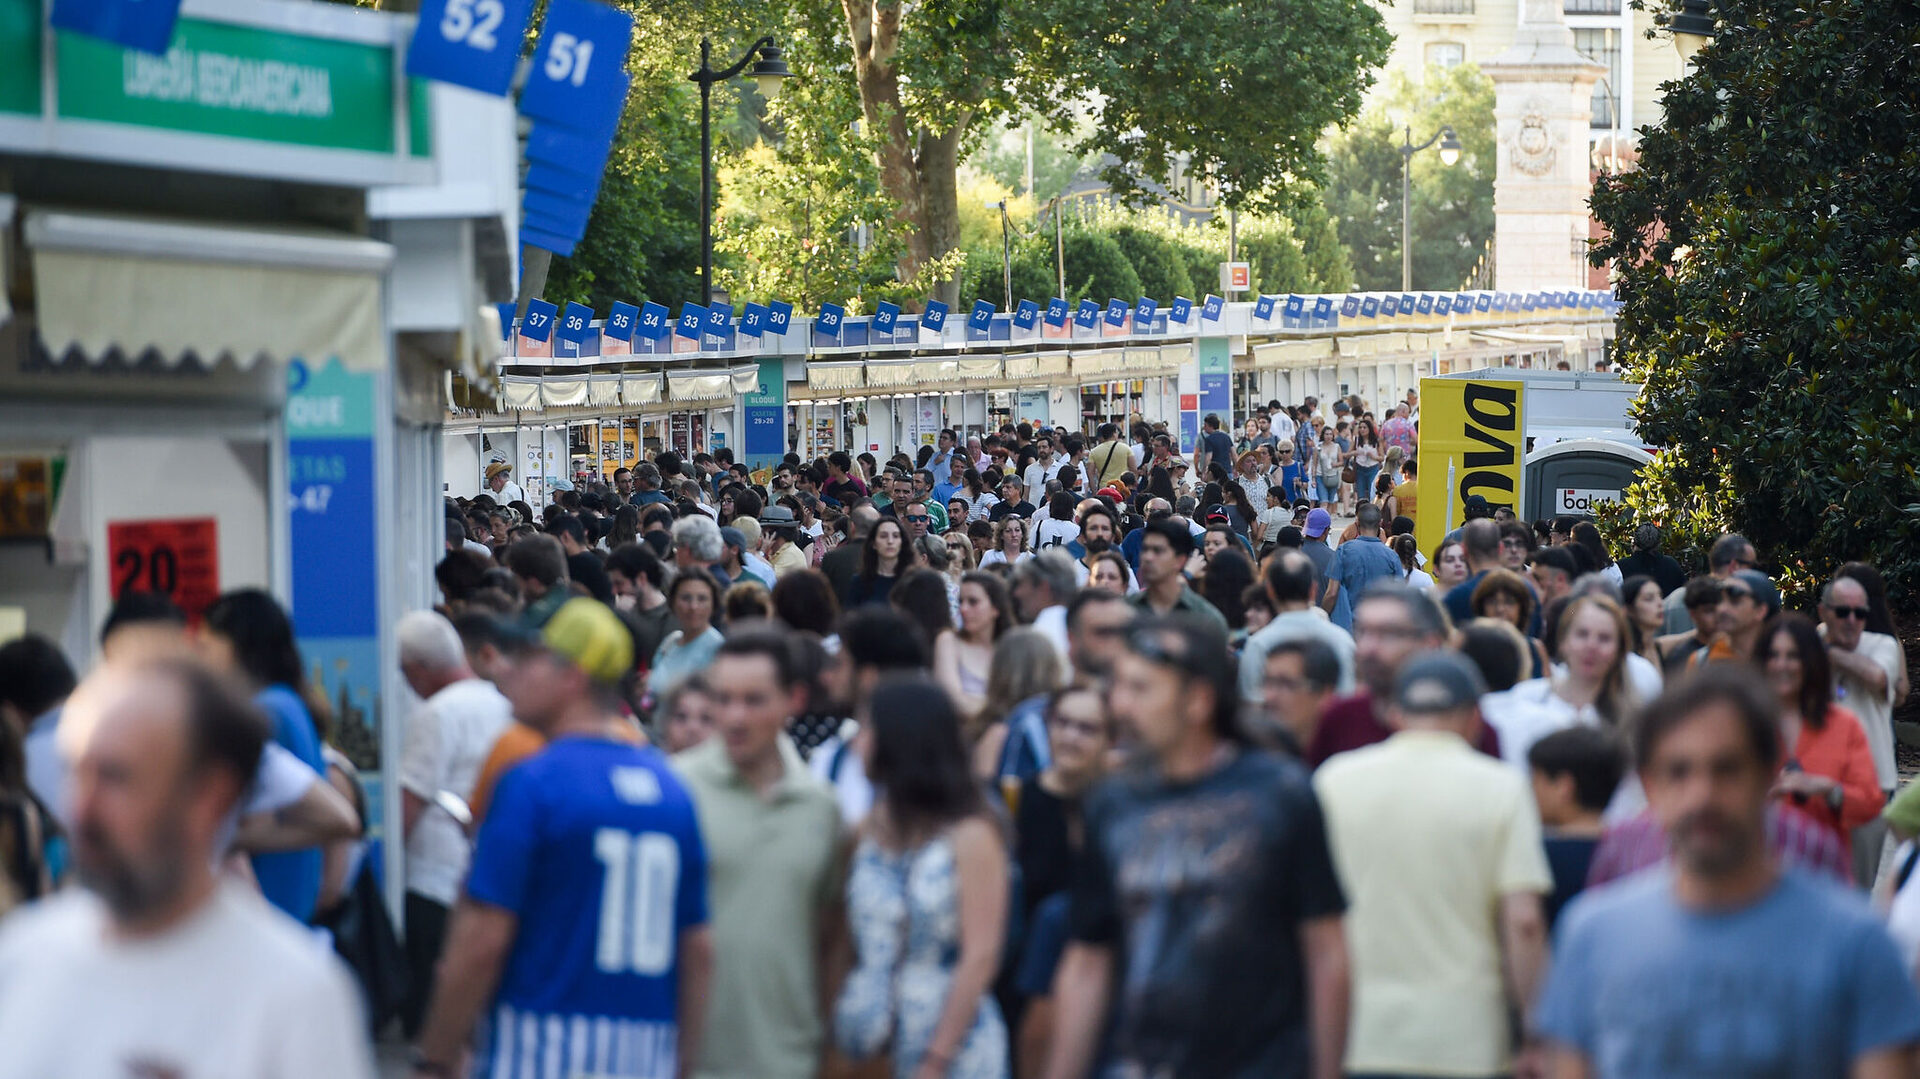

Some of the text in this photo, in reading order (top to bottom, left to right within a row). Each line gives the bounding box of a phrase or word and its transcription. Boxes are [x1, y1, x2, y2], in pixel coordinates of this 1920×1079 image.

[440, 0, 505, 51] 52
[544, 32, 594, 87] 51
[1176, 306, 1185, 315] 21
[1207, 303, 1218, 313] 20
[1260, 304, 1269, 312] 19
[1347, 302, 1355, 310] 17
[1403, 301, 1410, 309] 14
[928, 310, 941, 321] 28
[976, 310, 988, 320] 27
[1020, 309, 1032, 320] 26
[1050, 307, 1061, 317] 25
[1080, 309, 1092, 319] 24
[1111, 308, 1122, 318] 23
[1139, 306, 1150, 316] 22
[530, 313, 547, 327] 37
[567, 316, 583, 330] 36
[614, 314, 628, 328] 35
[644, 314, 658, 327] 34
[684, 315, 698, 328] 33
[711, 312, 724, 325] 32
[747, 314, 759, 325] 31
[771, 312, 785, 324] 30
[823, 313, 837, 325] 29
[878, 312, 891, 323] 29
[1210, 356, 1219, 366] 2
[759, 383, 768, 396] 3
[750, 396, 776, 404] BLOQUE
[288, 396, 342, 426] QUE
[116, 545, 177, 599] 20
[595, 828, 681, 976] 10
